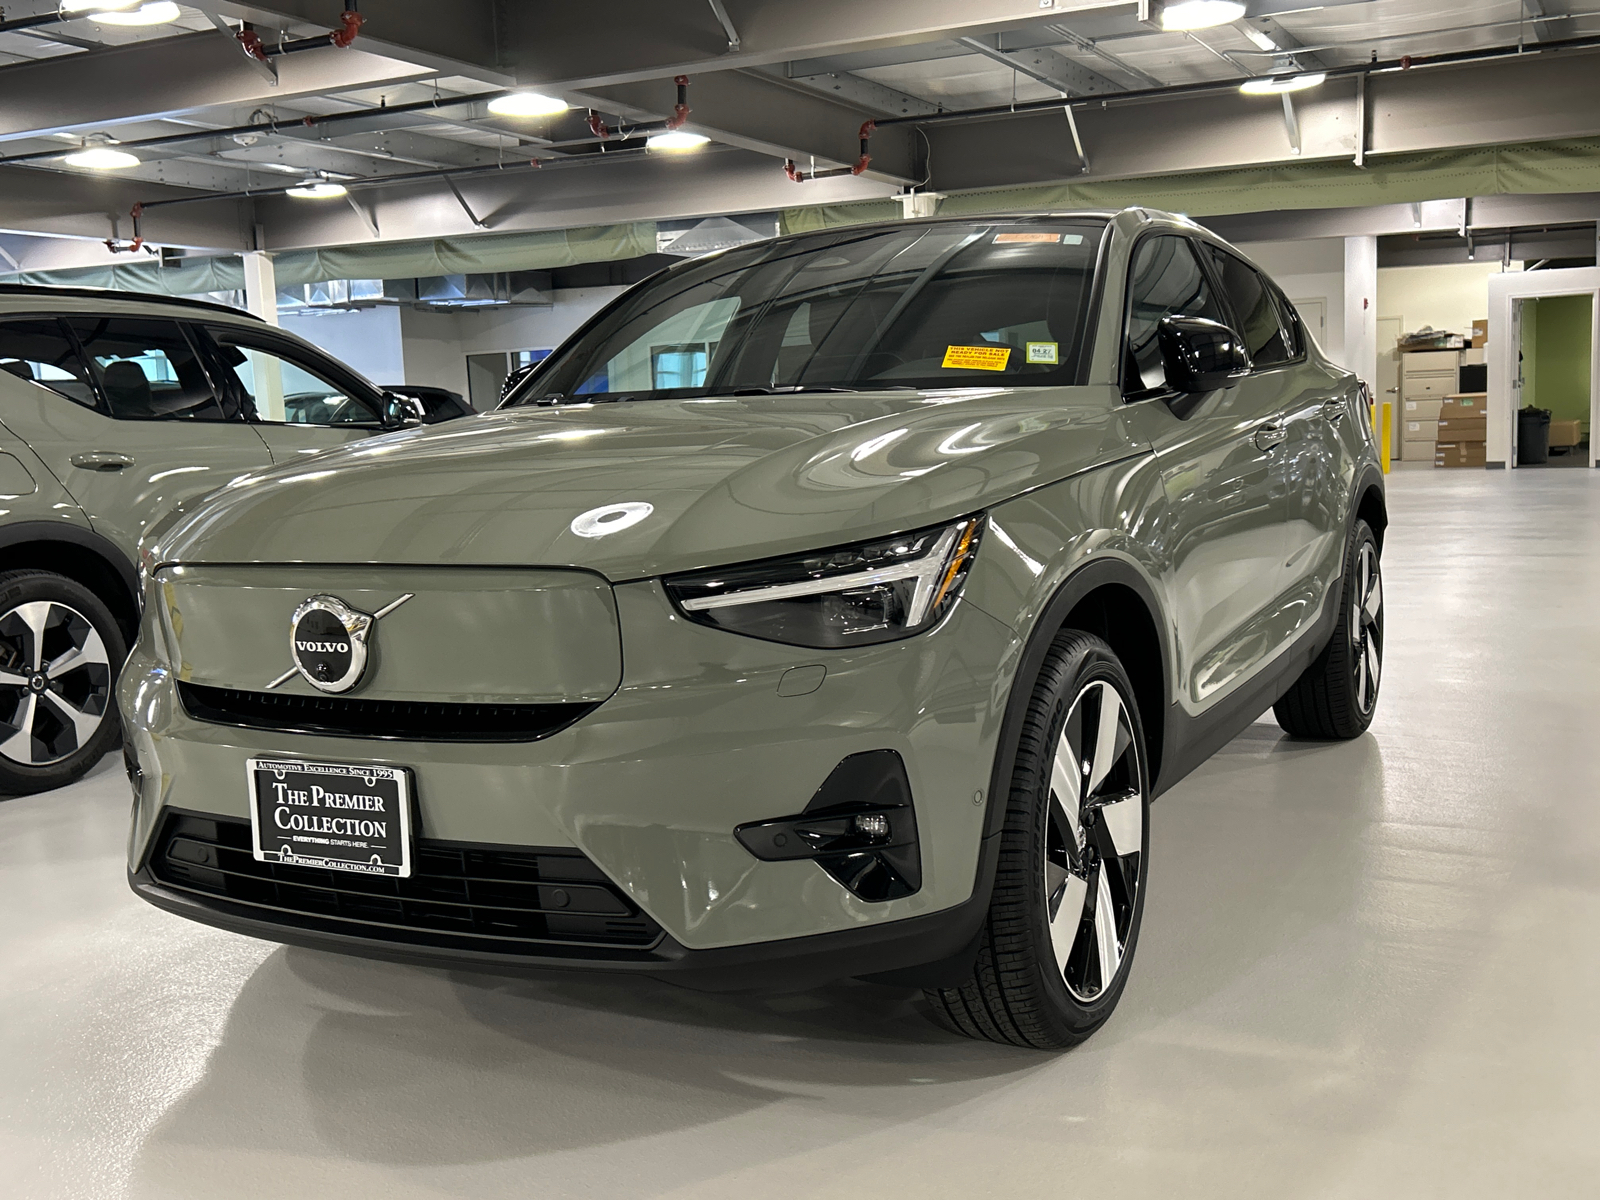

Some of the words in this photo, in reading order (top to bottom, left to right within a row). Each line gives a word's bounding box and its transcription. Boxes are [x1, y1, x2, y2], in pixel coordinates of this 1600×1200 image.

[296, 641, 349, 653] VOLVO
[258, 761, 303, 771] AUTOMOTIVE
[304, 764, 346, 774] EXCELLENCE
[349, 767, 371, 777] SINCE
[373, 769, 393, 778] 1995
[272, 782, 309, 806] THE
[310, 785, 385, 812] PREMIER
[1033, 766, 1046, 906] SCORPION
[1044, 698, 1063, 761] ZERO
[274, 806, 387, 838] COLLECTION
[292, 835, 330, 845] EVERYTHING
[330, 838, 351, 847] STARTS
